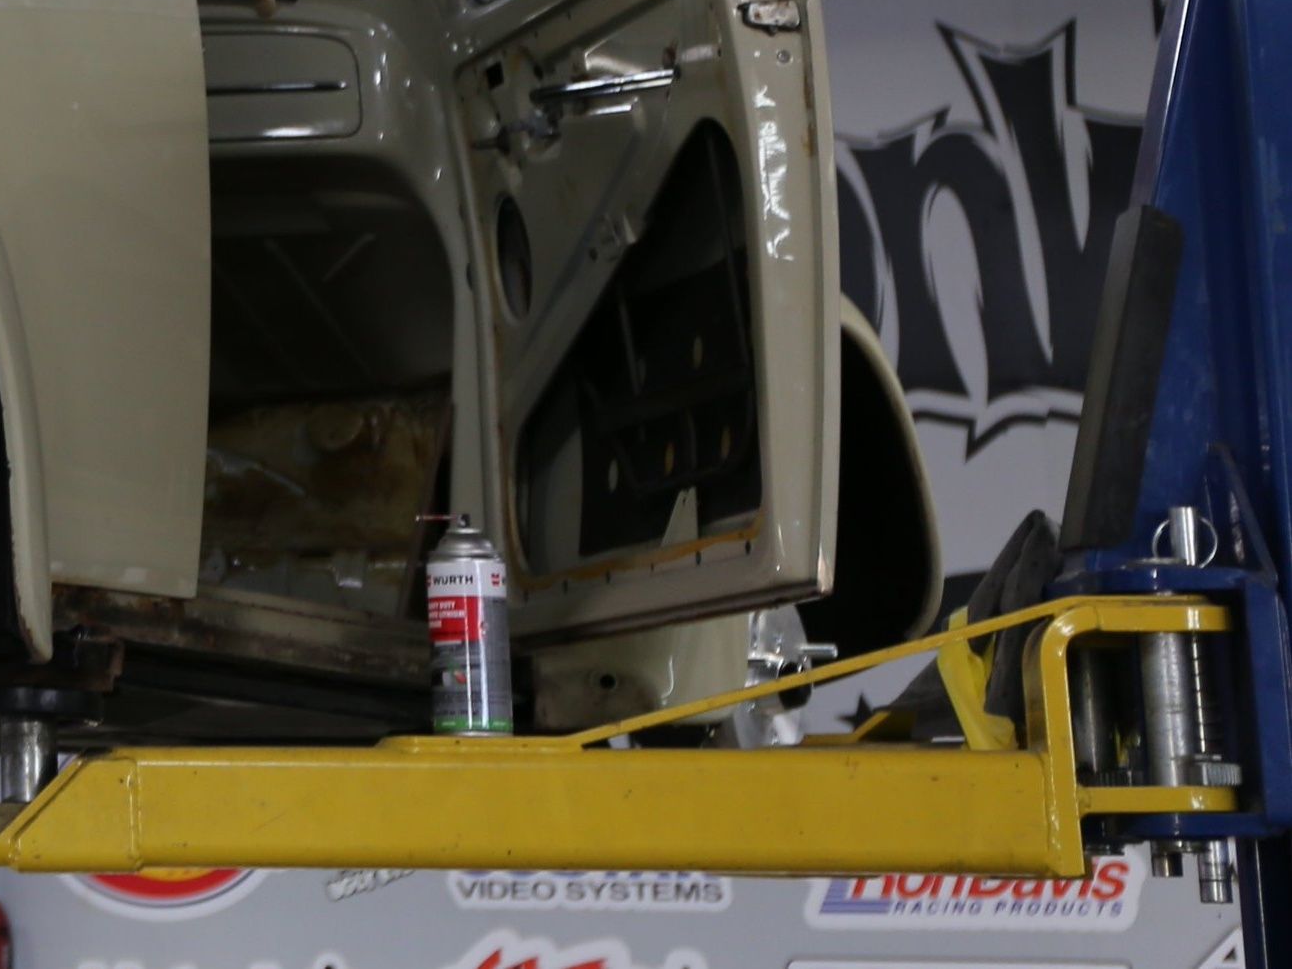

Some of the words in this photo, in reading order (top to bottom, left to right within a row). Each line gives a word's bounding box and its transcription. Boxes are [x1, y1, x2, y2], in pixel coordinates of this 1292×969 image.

[457, 879, 556, 901] VIDEO
[566, 880, 723, 903] SYSTEMS
[891, 899, 982, 916] RACING
[993, 899, 1124, 917] PRODUCTS
